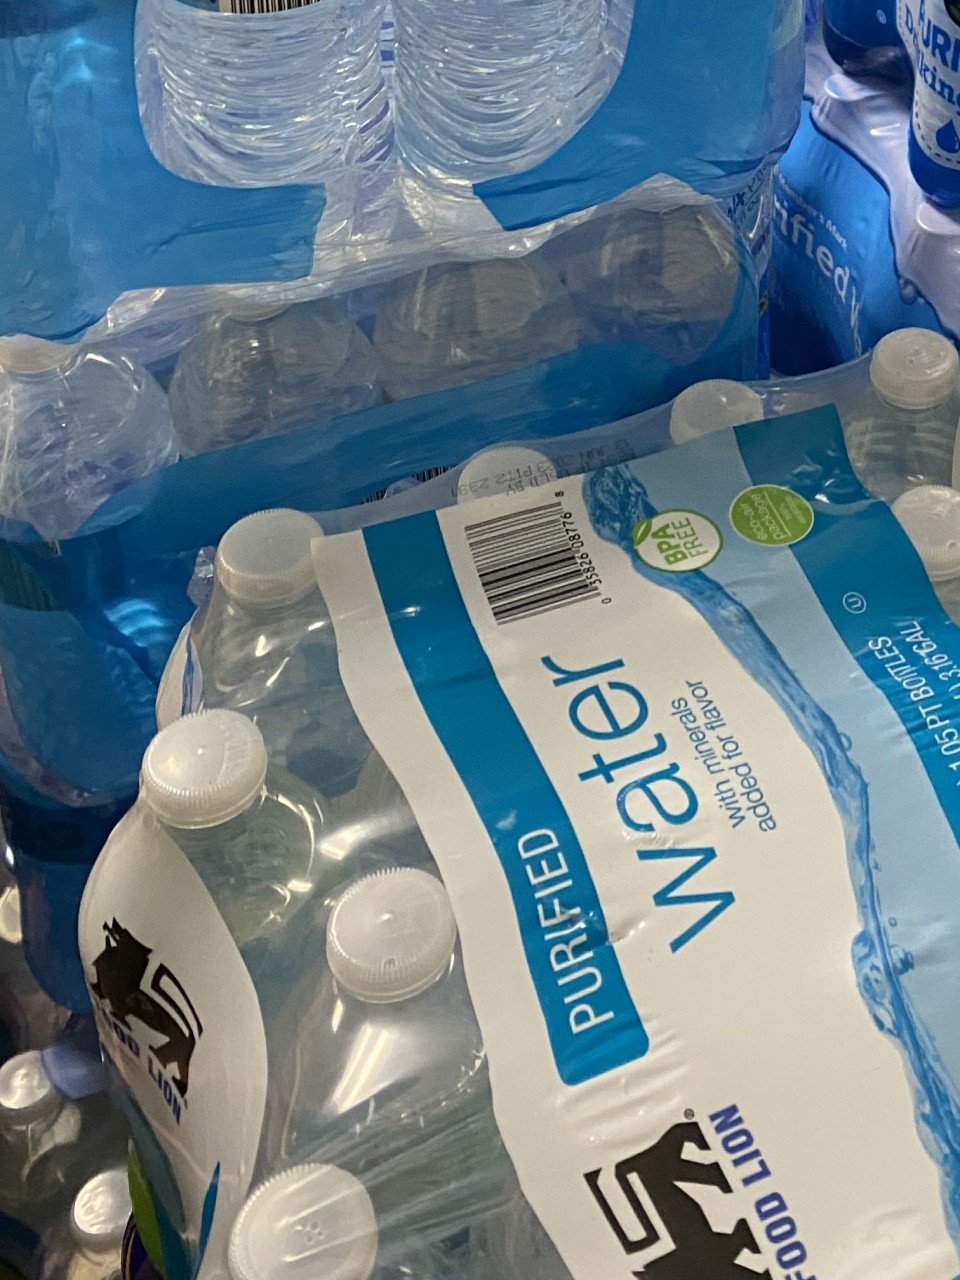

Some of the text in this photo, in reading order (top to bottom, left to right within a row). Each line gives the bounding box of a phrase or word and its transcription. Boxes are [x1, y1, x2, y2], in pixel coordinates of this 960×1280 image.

[560, 511, 584, 550] 08776
[651, 523, 688, 565] BPA
[671, 517, 709, 558] FREE
[580, 552, 603, 588] 35826
[601, 597, 612, 605] 0
[867, 635, 935, 702] BOTTLES
[918, 703, 950, 730] PT
[671, 696, 746, 829] with minerals
[685, 679, 777, 833] added for flavor
[540, 655, 736, 954] Water
[517, 828, 615, 1035] PURIFIED
[148, 1054, 181, 1126] LION
[708, 1103, 772, 1188] LION
